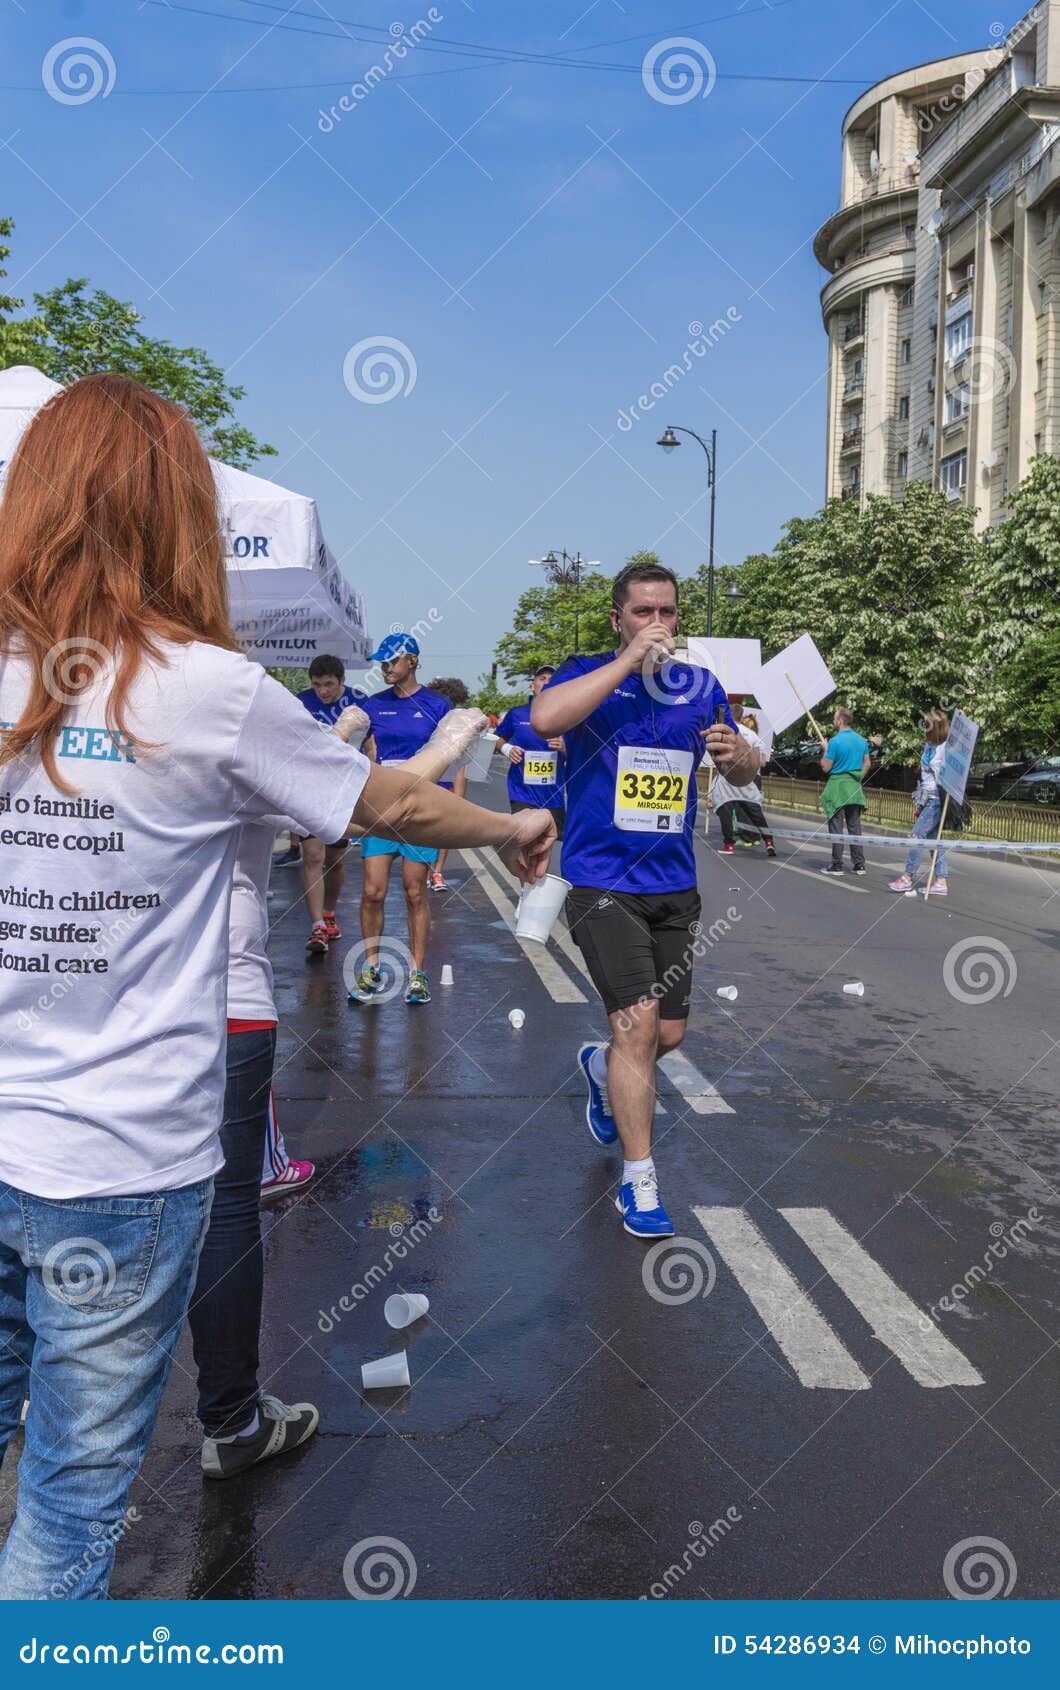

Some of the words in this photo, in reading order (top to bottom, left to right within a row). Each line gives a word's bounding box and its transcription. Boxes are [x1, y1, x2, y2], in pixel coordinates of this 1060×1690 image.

[528, 761, 553, 773] 1565
[622, 773, 684, 802] 3322
[15, 798, 30, 814] o
[34, 794, 115, 820] familie
[637, 801, 673, 811] MIROSLAV
[0, 829, 60, 850] ecare
[63, 831, 125, 856] copil
[59, 891, 161, 912] children
[30, 924, 101, 943] suffer
[54, 957, 109, 974] care
